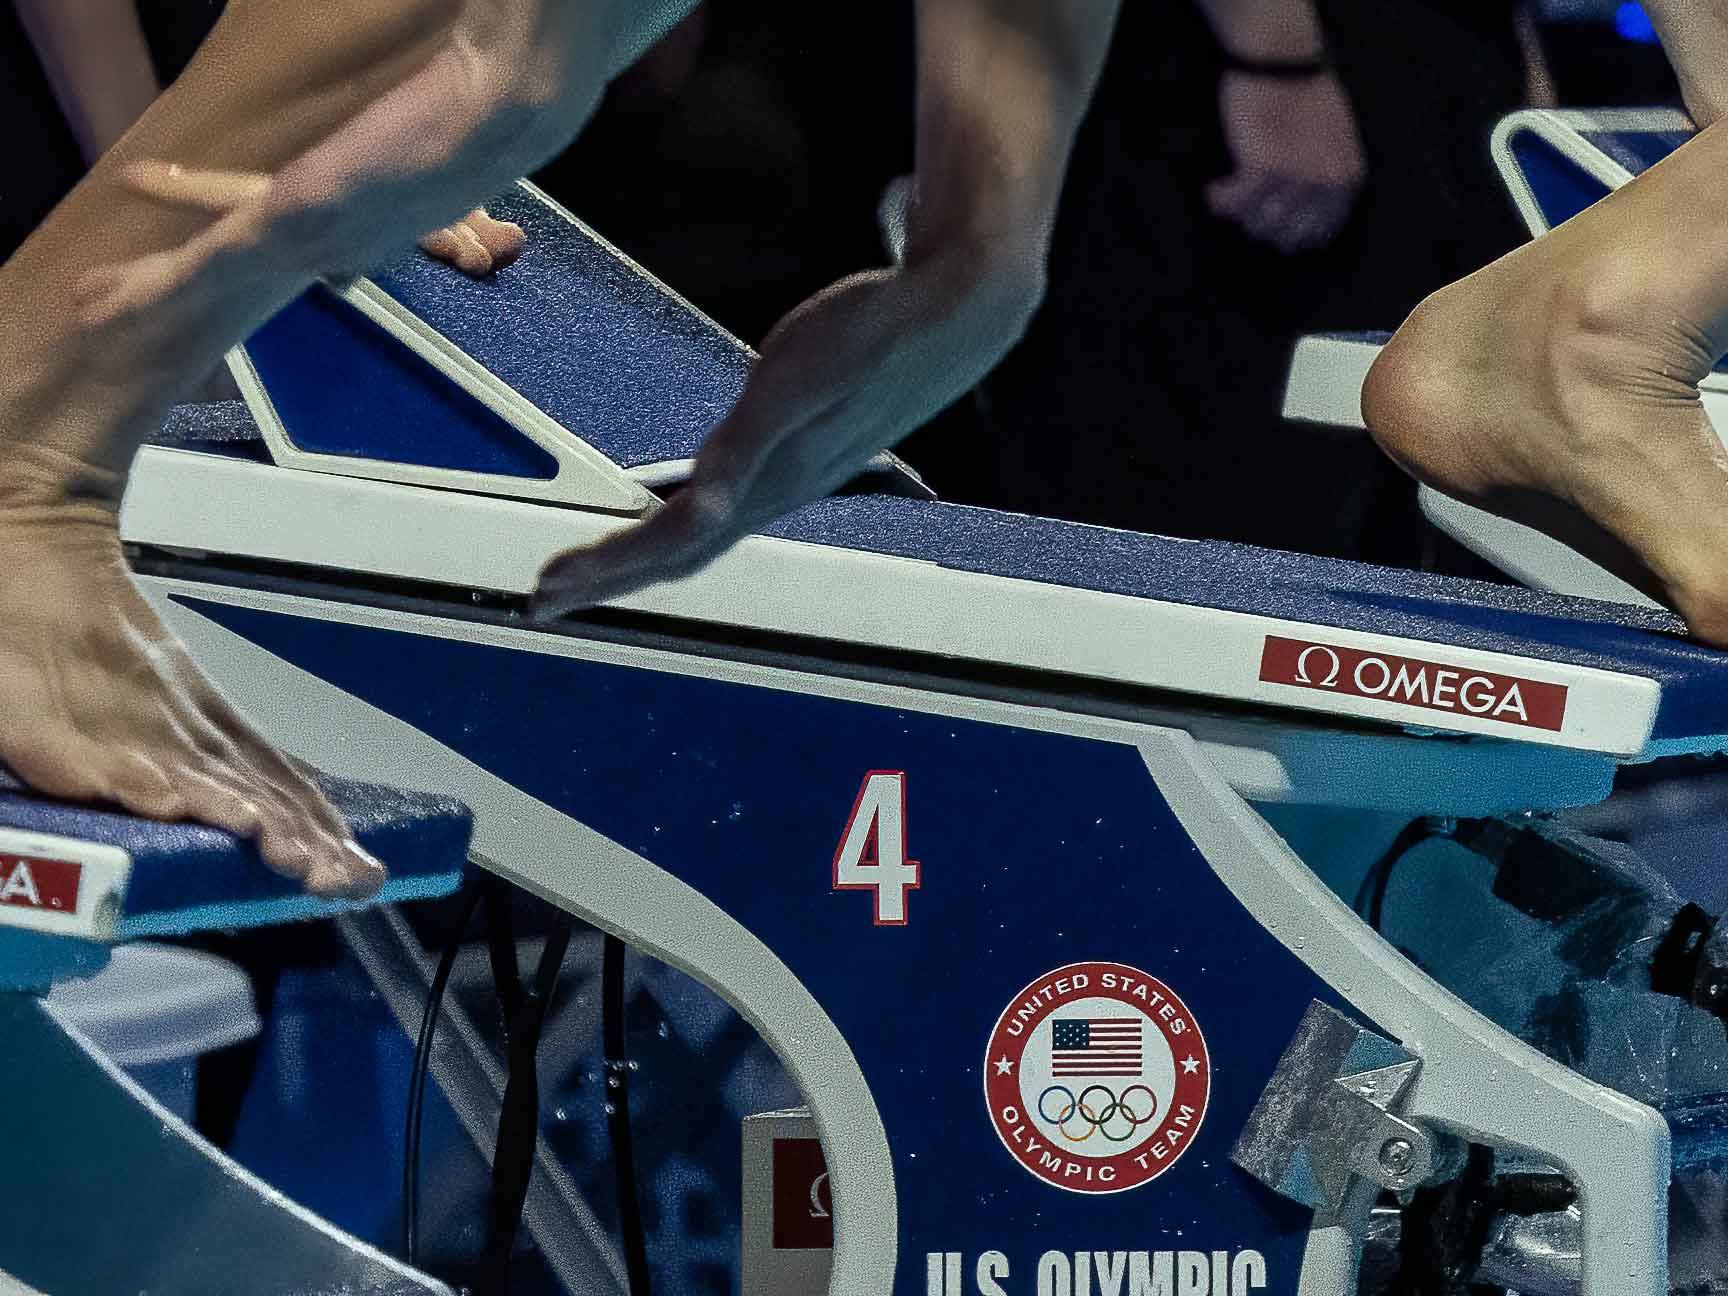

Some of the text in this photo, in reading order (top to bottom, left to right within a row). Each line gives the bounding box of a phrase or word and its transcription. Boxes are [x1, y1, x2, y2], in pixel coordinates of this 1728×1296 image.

[1353, 657, 1529, 722] OMEGA
[832, 769, 921, 926] 4
[1006, 973, 1186, 1037] UNITED STATES
[1002, 1104, 1196, 1182] OLYMPIC TEAM
